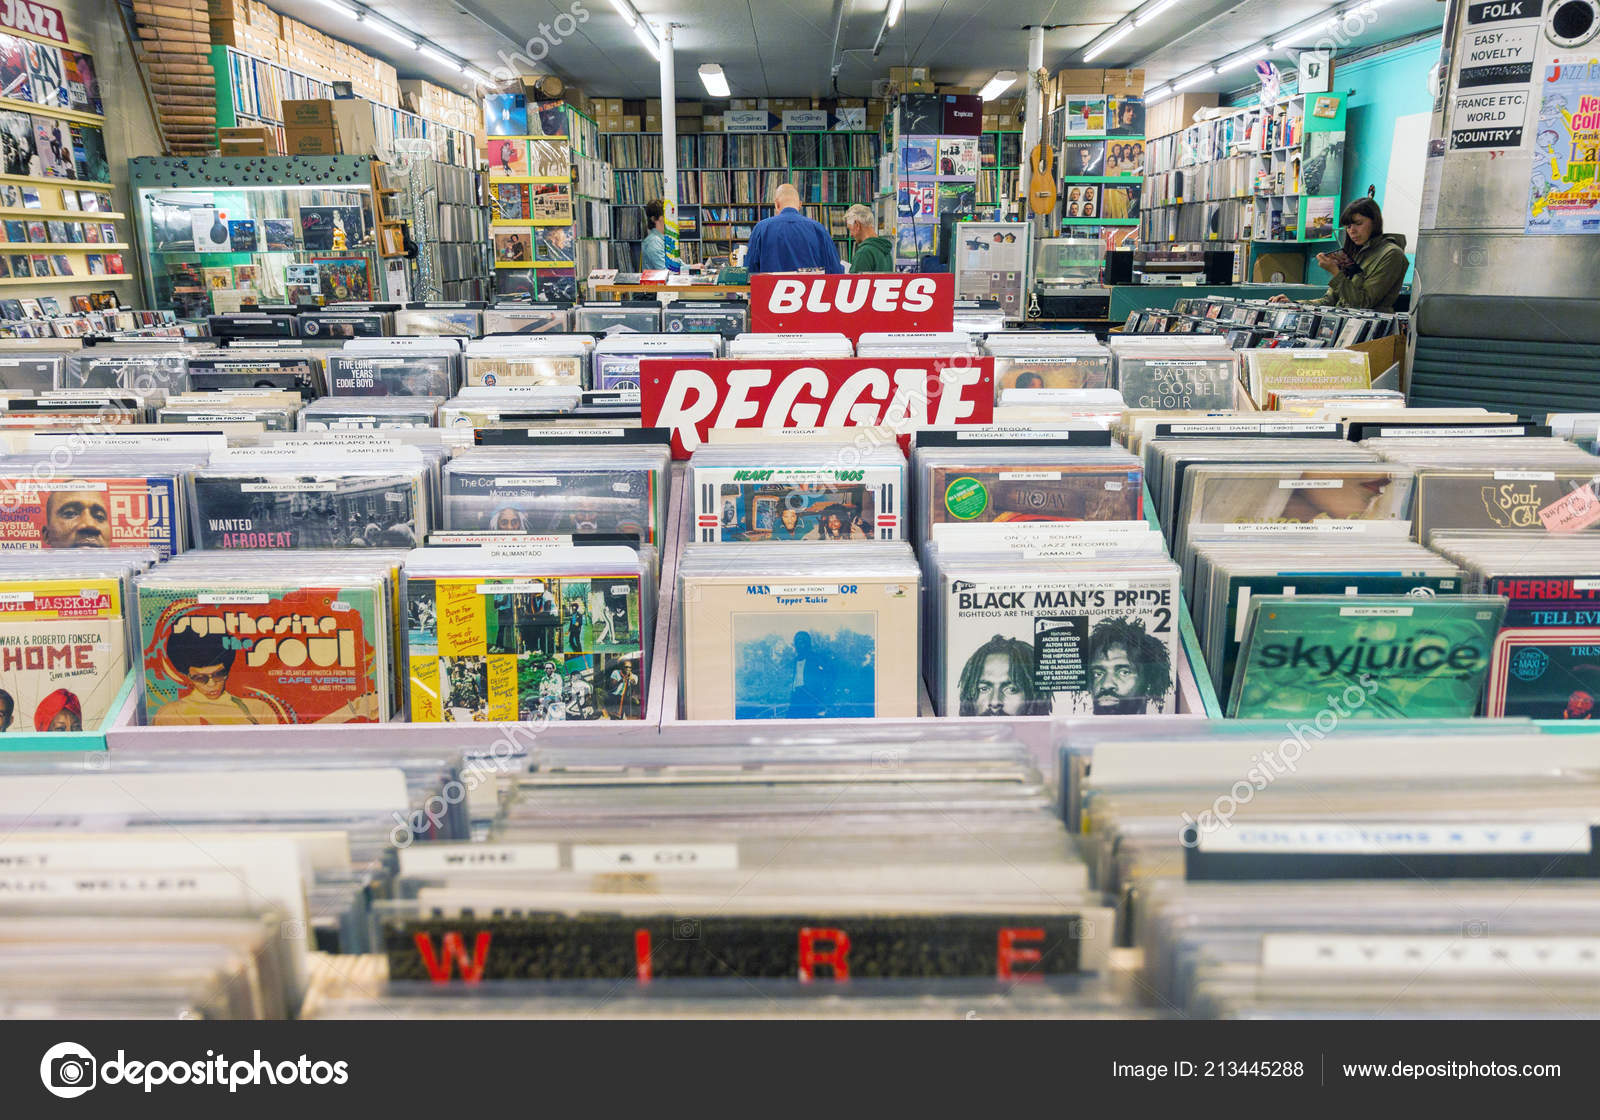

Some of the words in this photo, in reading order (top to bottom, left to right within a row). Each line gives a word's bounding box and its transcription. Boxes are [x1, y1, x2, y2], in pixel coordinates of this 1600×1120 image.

[1482, 2, 1523, 19] FOLK
[1, 0, 63, 40] JAZZ
[1474, 33, 1503, 46] EASY
[1471, 47, 1522, 61] NOVELTY
[1456, 95, 1496, 109] FRANCE
[1498, 95, 1525, 106] ETC.
[1467, 111, 1506, 122] WORLD
[1457, 130, 1513, 142] COUNTRY
[768, 278, 936, 314] BLUES
[339, 360, 354, 369] FIVE
[355, 360, 373, 369] LONG
[351, 369, 373, 378] YEARS
[1155, 369, 1216, 381] BAPTIST
[336, 378, 356, 388] EDDIE
[356, 378, 373, 388] BOYD
[1158, 383, 1221, 395] GOSPEL
[1139, 396, 1192, 409] CHOIR
[654, 367, 981, 452] REGGAE
[733, 470, 774, 482] HEART
[460, 478, 477, 488] The
[489, 489, 518, 497] Morning
[520, 489, 535, 497] Star
[1511, 505, 1542, 526] CAL
[0, 521, 35, 529] SYSTEM
[112, 526, 170, 537] MACHINE
[208, 519, 252, 531] WANTED
[7, 529, 40, 537] POWER
[223, 532, 292, 548] AFROBEAT
[34, 594, 110, 610] MASEKELA
[776, 597, 802, 606] Tapper
[959, 592, 1026, 609] BLACK
[1033, 591, 1105, 608] MAN'S
[1114, 590, 1171, 606] PRIDE
[1153, 608, 1171, 633] 2
[1531, 611, 1572, 625] TELL
[173, 612, 337, 638] synthesize
[23, 635, 29, 644] &
[32, 634, 66, 644] ROBERTO
[68, 634, 102, 643] FONSECA
[222, 636, 253, 650] the
[248, 629, 356, 667] soul
[3, 645, 96, 672] HOME
[1257, 636, 1482, 676] skyjuice
[1519, 660, 1540, 668] MAXI
[278, 676, 313, 684] CAPE
[314, 676, 356, 684] VERDE
[444, 852, 519, 865] WIRE
